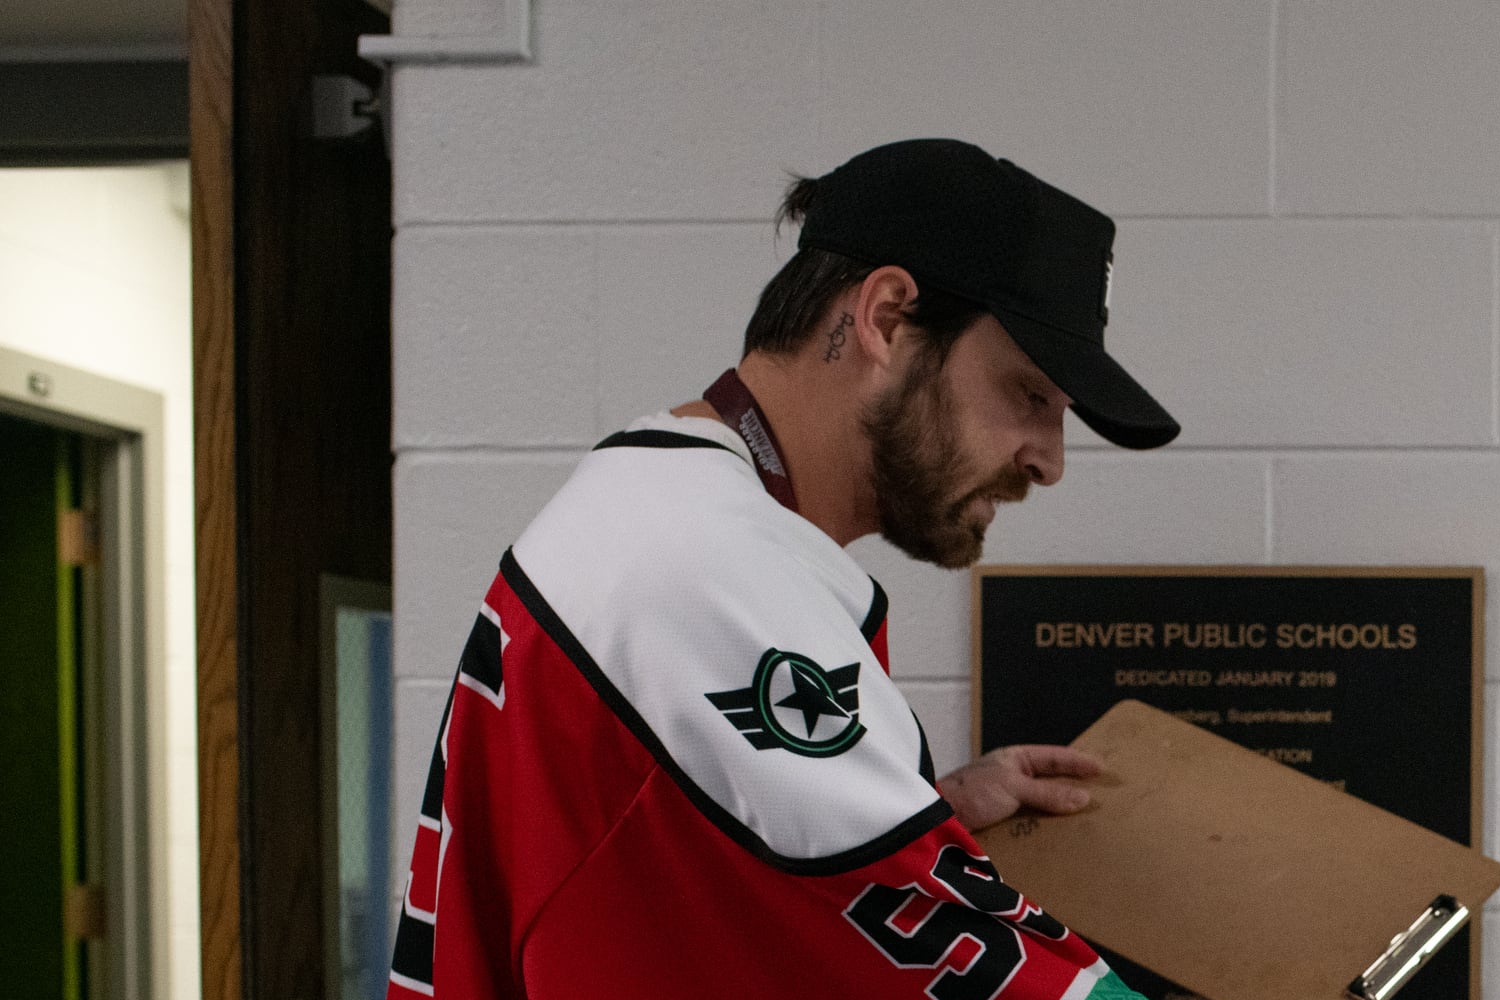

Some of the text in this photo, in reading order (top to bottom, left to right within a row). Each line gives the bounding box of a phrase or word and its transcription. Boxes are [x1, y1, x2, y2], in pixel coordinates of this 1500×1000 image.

[1035, 622, 1418, 649] DENVER PUBLIC SCHOOLS
[1115, 669, 1212, 687] DEDICATED
[1215, 669, 1293, 687] JANUARY
